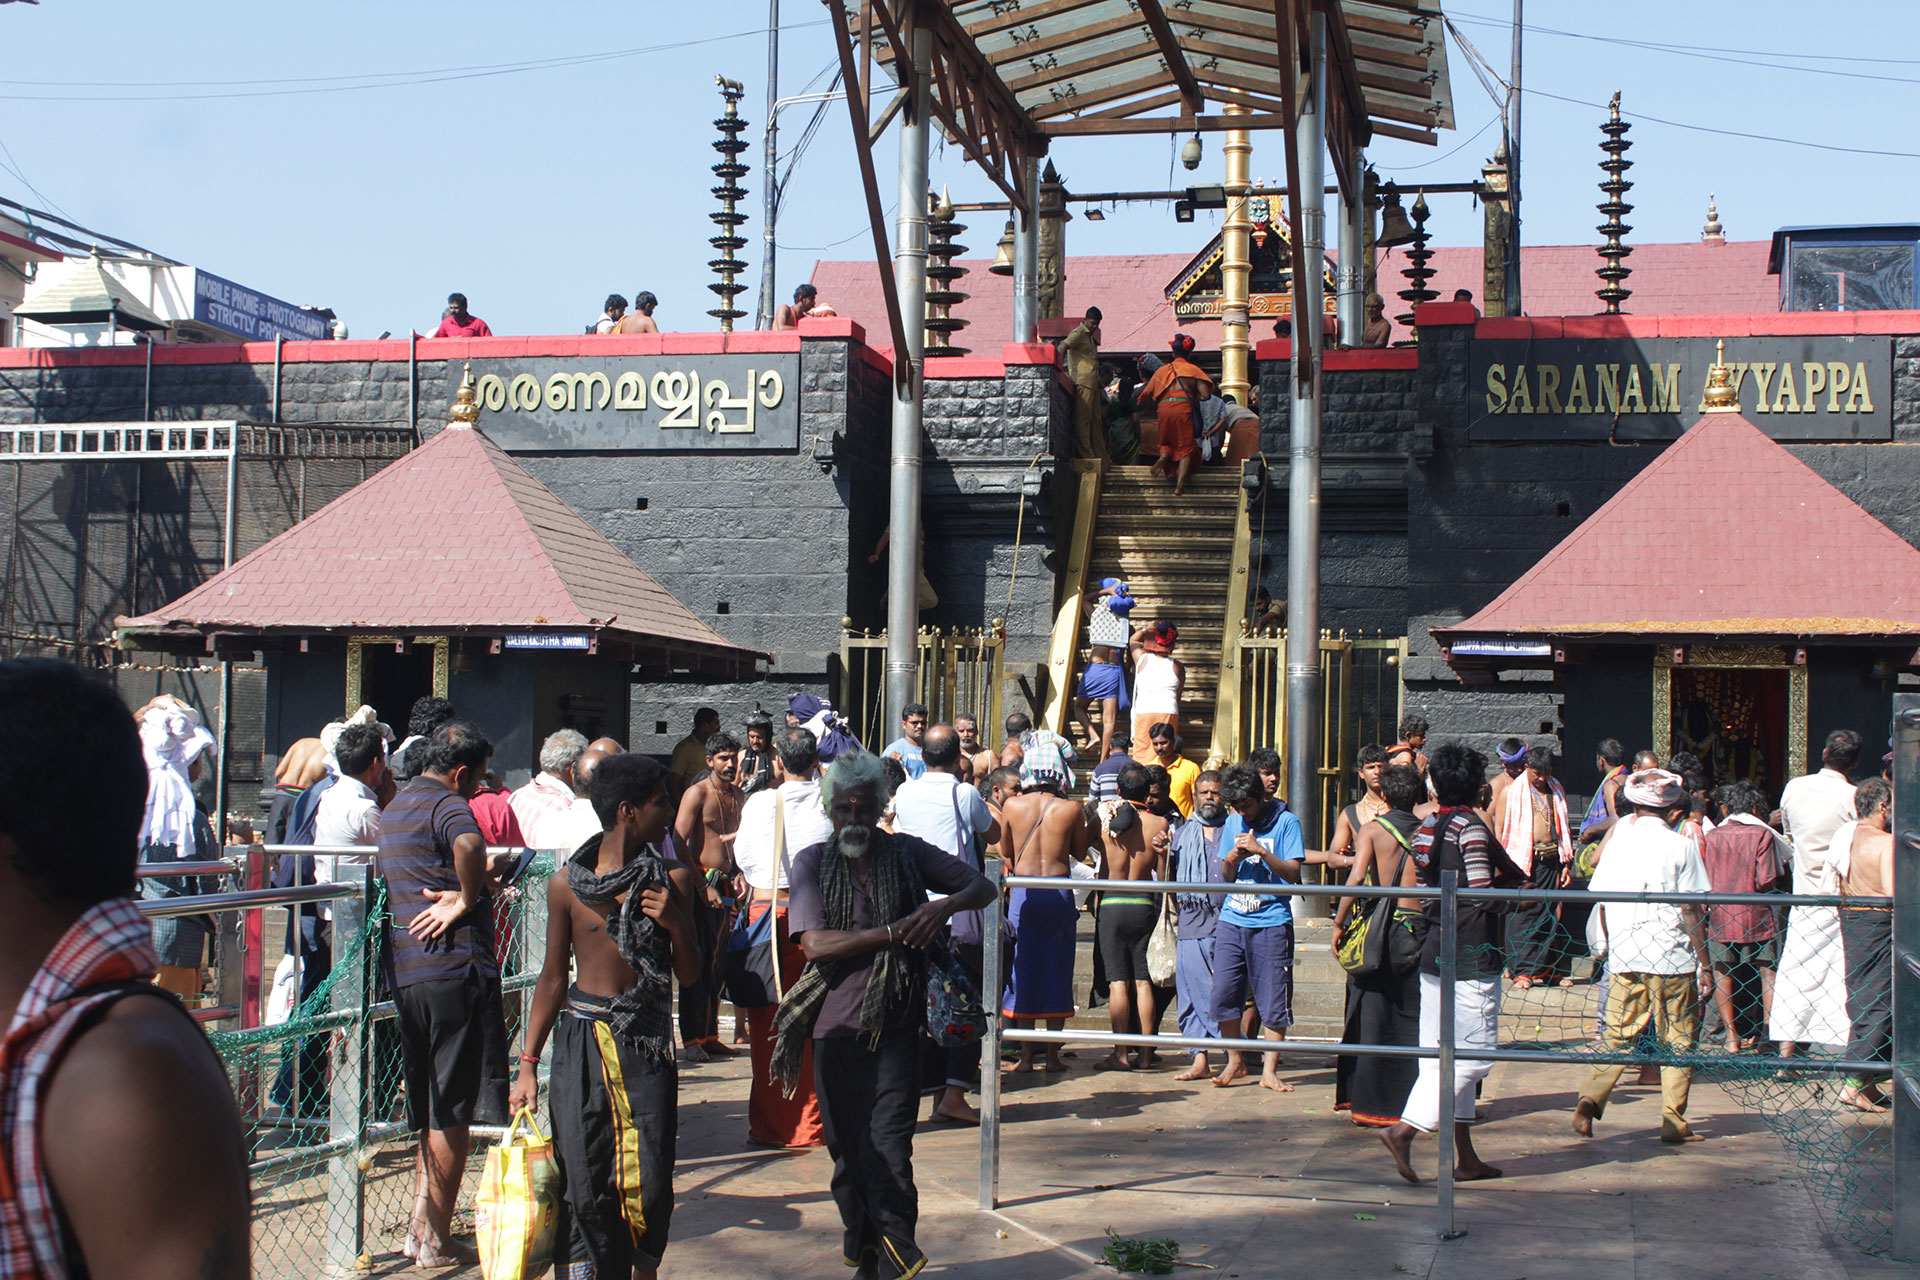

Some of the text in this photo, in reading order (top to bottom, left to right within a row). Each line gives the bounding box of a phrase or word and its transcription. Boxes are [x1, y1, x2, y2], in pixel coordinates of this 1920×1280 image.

[197, 275, 230, 305] MOBILE
[232, 288, 260, 316] PHONE
[267, 302, 325, 339] PHOTOGRAPHY
[208, 303, 256, 334] STRICTLY
[1486, 362, 1681, 414] SARANAM
